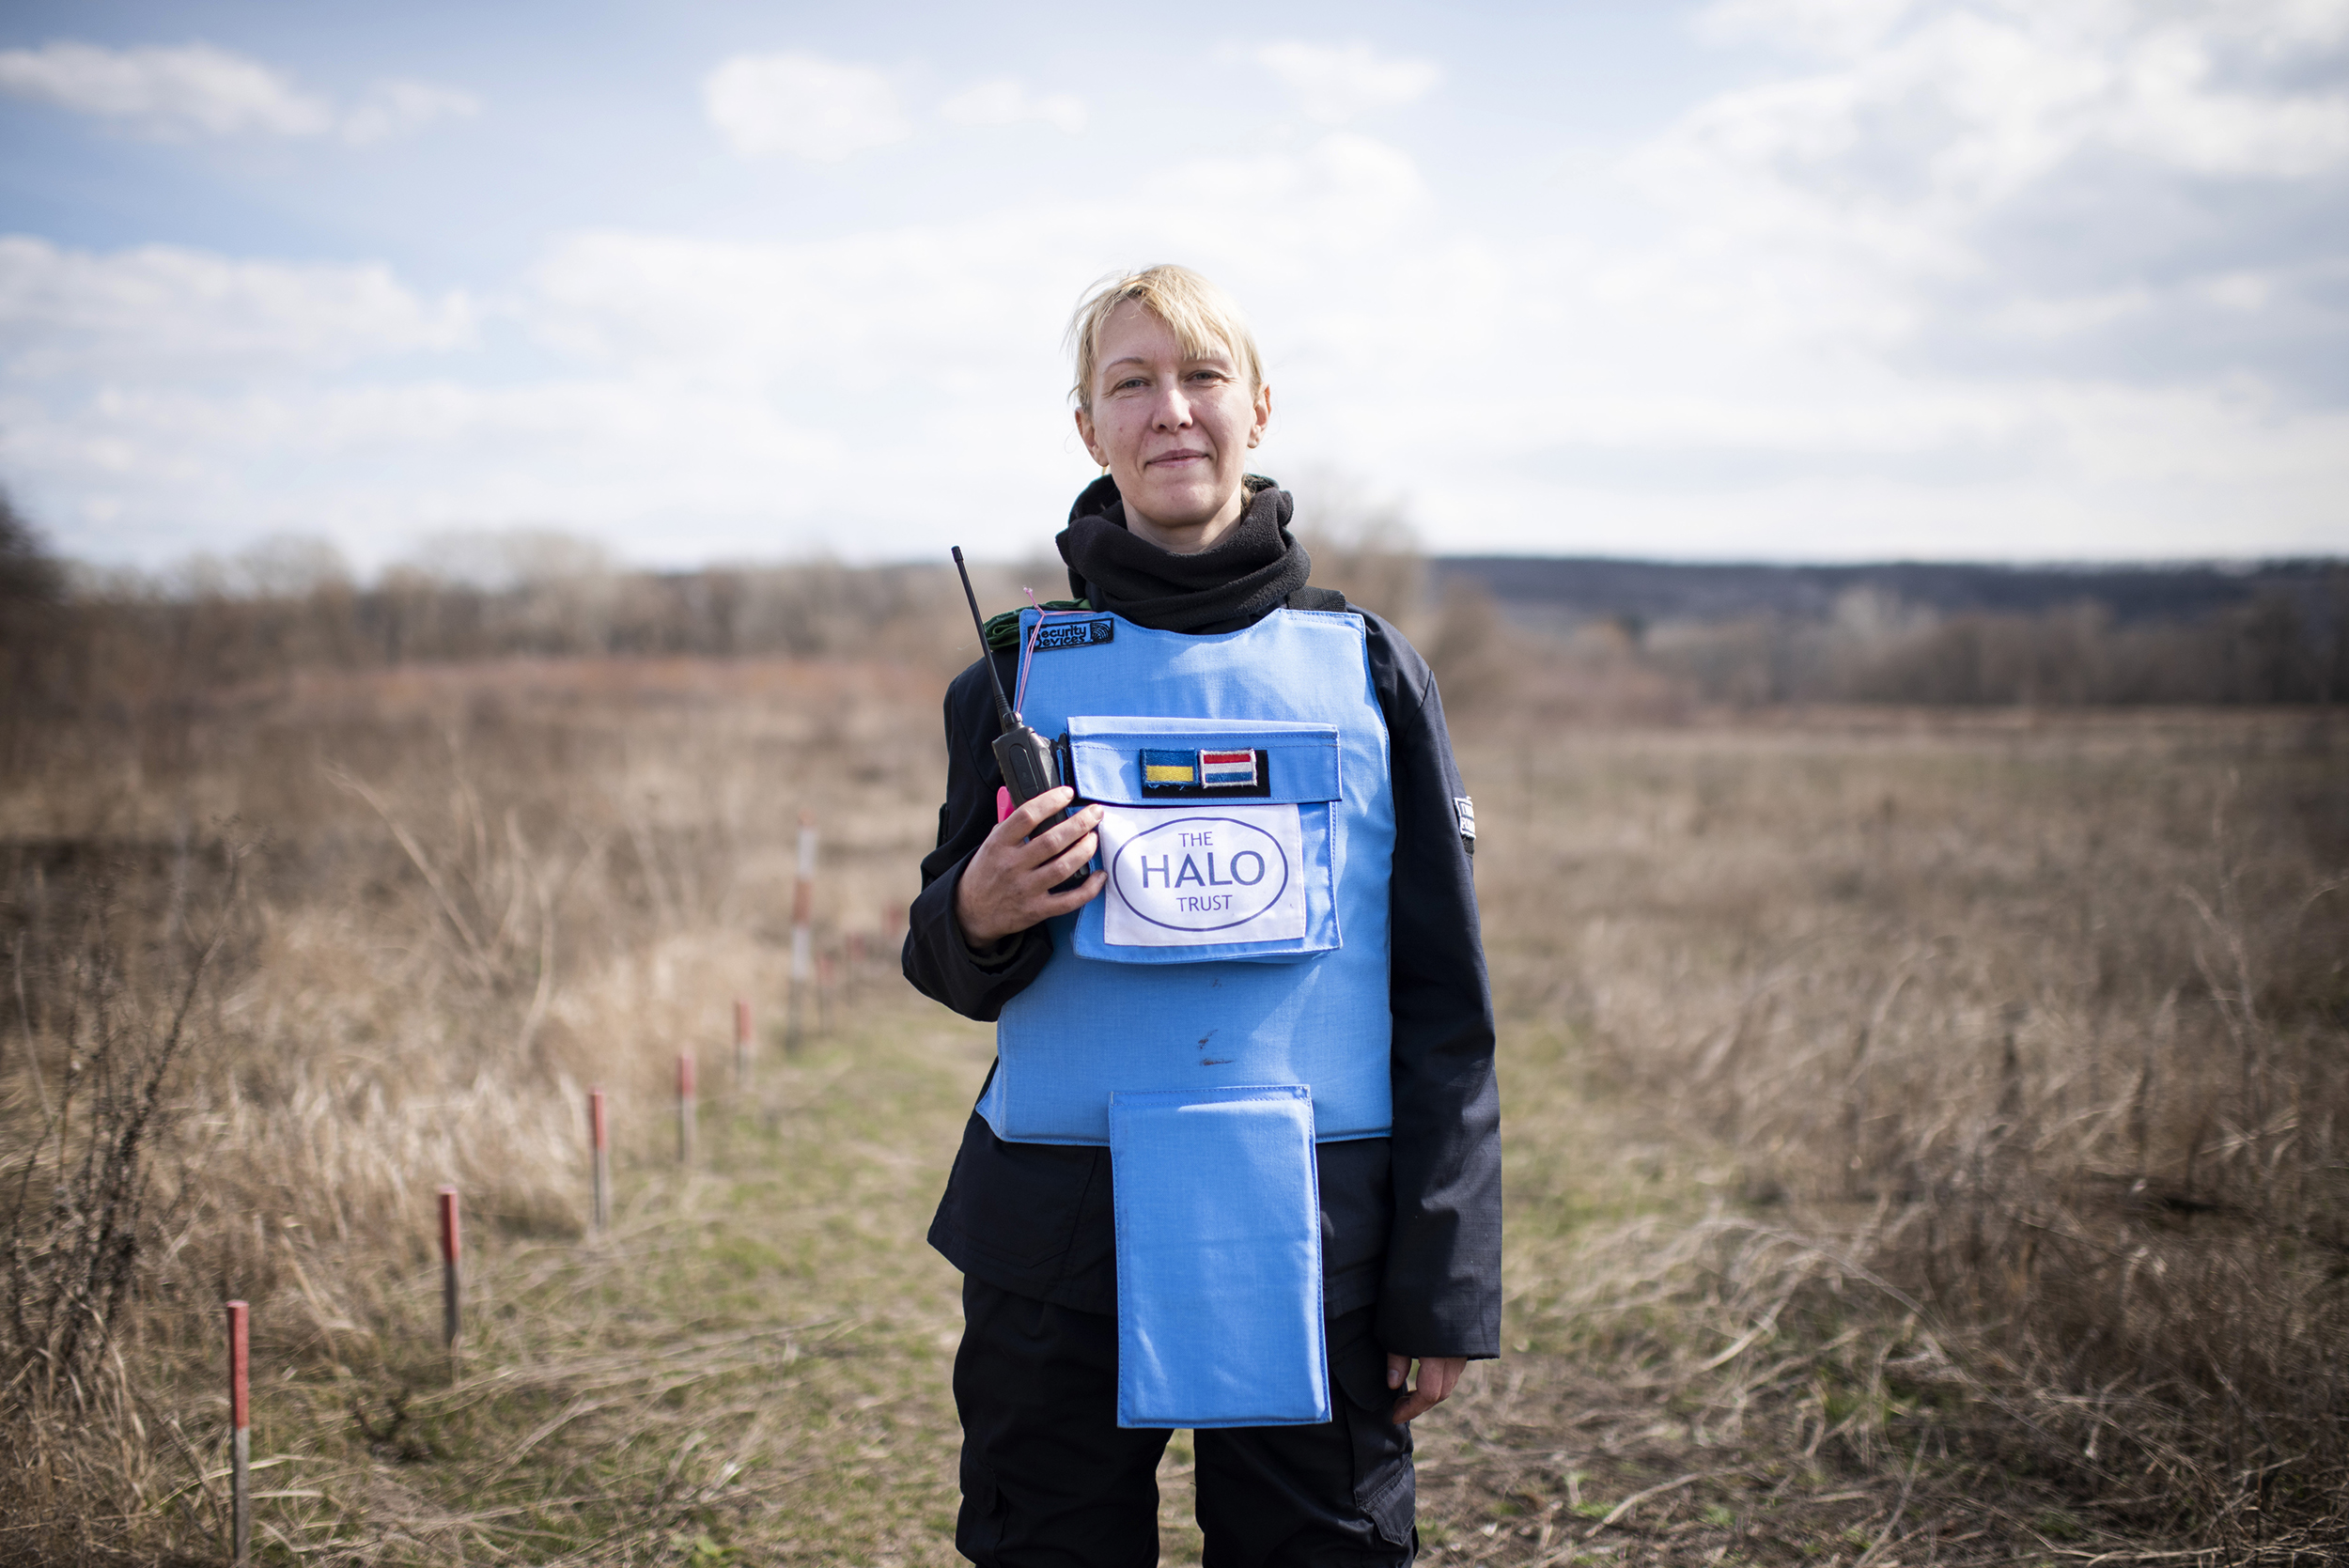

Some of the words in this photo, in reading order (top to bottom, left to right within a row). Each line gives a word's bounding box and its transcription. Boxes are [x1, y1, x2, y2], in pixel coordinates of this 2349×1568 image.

[1178, 831, 1214, 847] THE
[1141, 850, 1266, 889] HALO
[1176, 894, 1233, 912] TRUST
